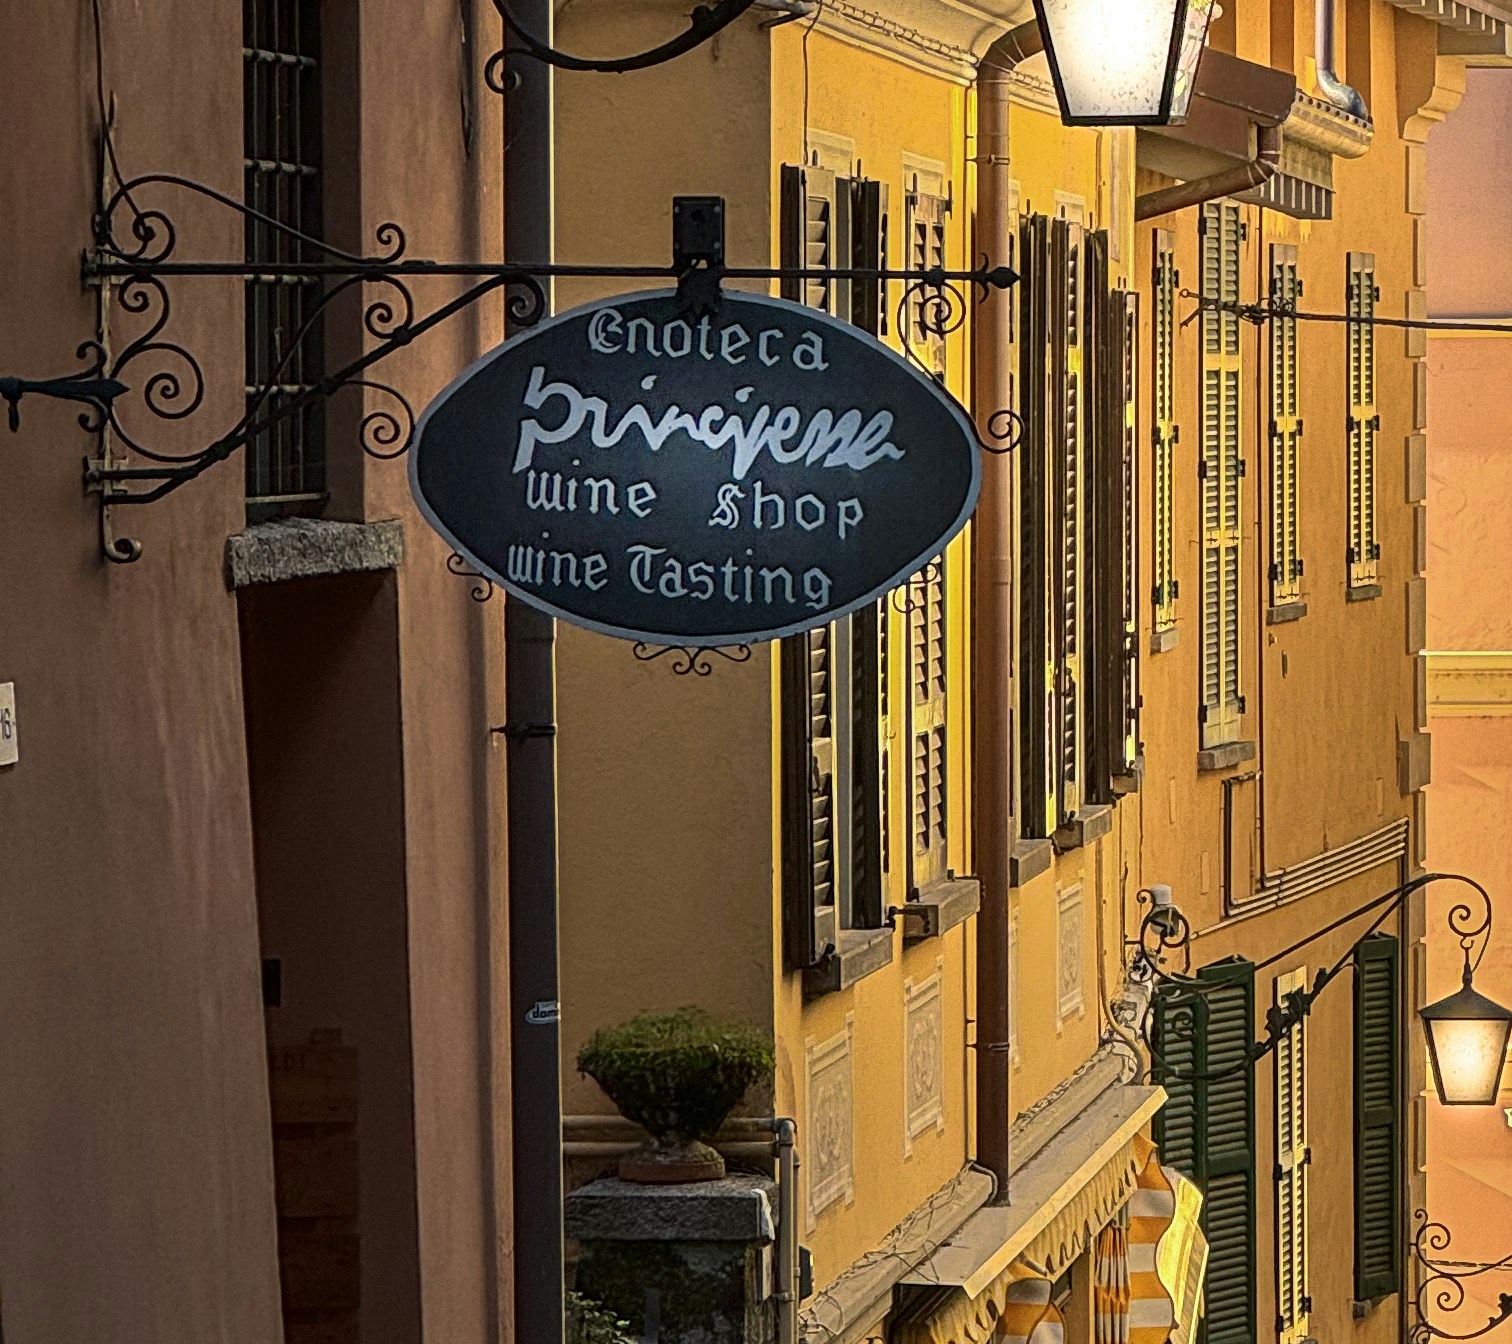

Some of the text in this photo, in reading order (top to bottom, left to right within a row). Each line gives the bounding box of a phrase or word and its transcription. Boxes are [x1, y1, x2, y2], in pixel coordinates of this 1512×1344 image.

[587, 307, 829, 372] Enoteca
[708, 480, 865, 540] Shop
[626, 544, 833, 610] Tasting
